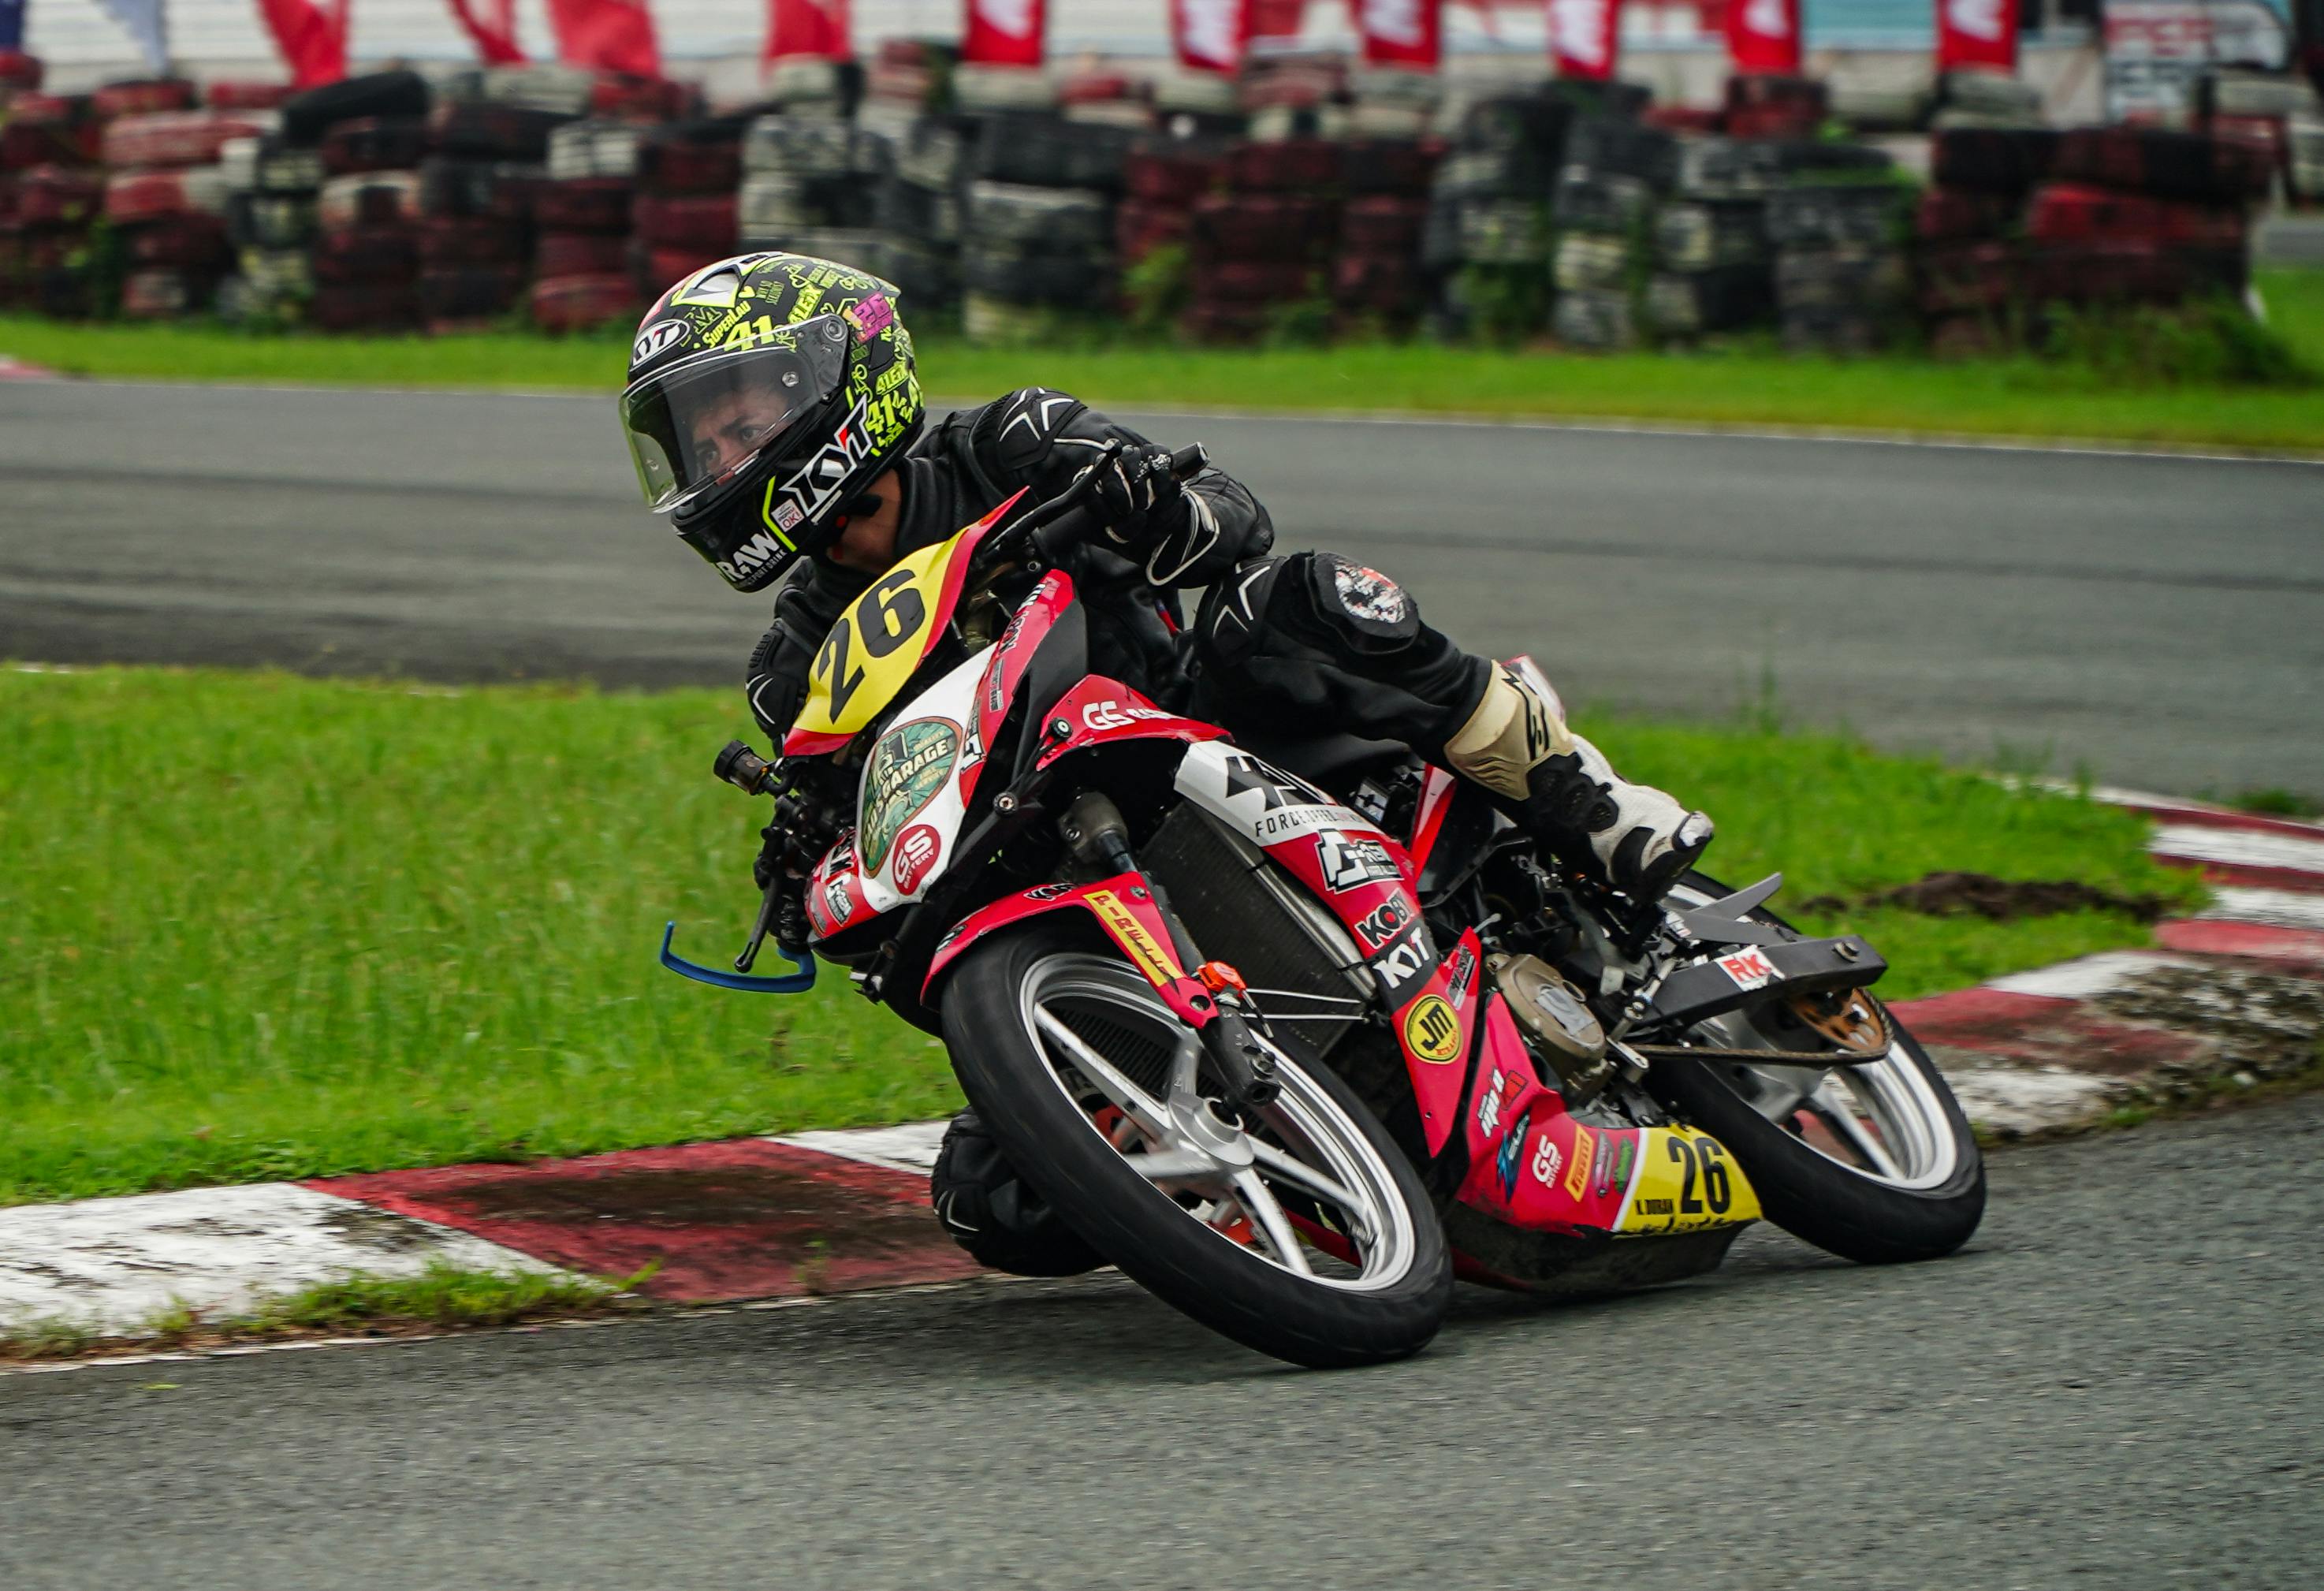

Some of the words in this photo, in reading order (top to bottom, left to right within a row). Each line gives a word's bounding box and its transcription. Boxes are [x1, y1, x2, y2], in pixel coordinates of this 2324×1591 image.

[724, 315, 775, 352] 41
[865, 394, 896, 434] 41
[779, 393, 873, 517] KYT
[716, 528, 780, 583] RAW
[817, 568, 926, 725] 26
[1082, 700, 1136, 731] GS
[881, 738, 948, 799] GARAGE
[894, 829, 933, 884] GS
[1372, 926, 1431, 989] KYT
[1720, 952, 1771, 984] RK
[1531, 1134, 1559, 1183] GS
[1667, 1135, 1731, 1215] 26
